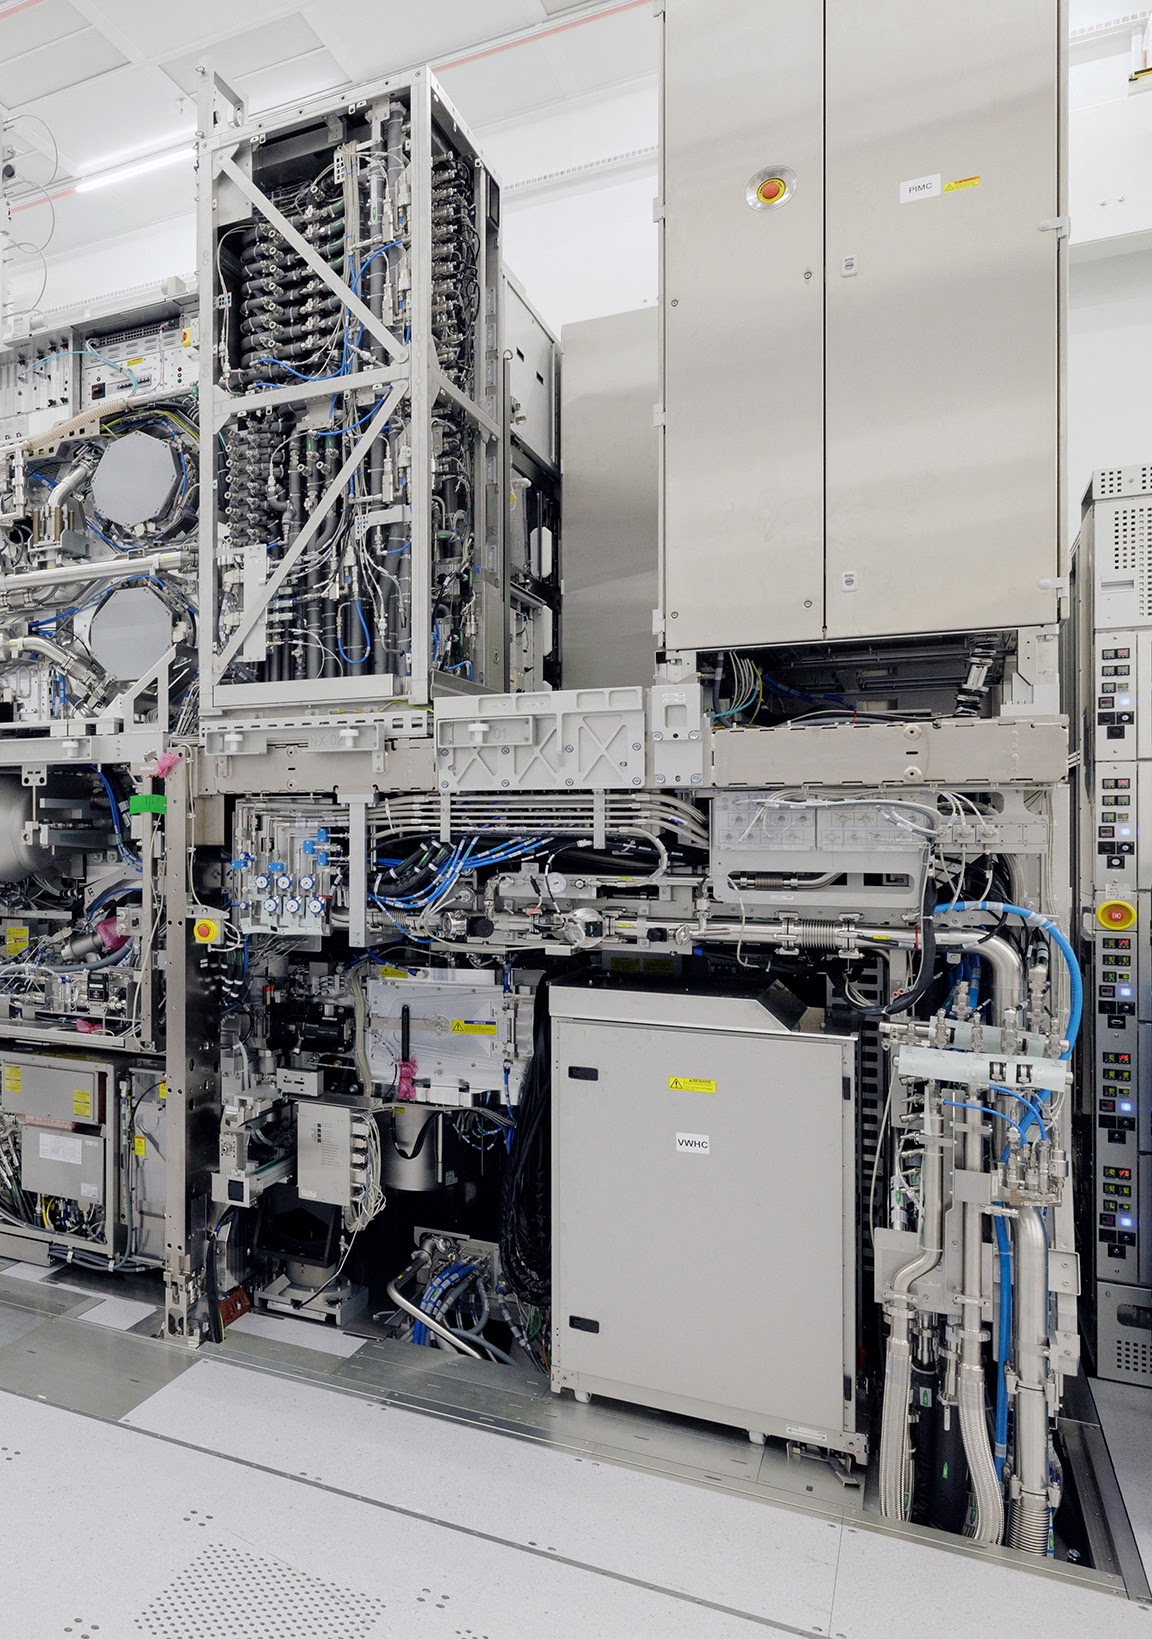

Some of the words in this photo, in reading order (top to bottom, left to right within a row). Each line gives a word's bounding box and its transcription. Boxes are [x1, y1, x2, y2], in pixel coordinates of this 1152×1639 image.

[908, 182, 933, 194] PIMC
[310, 735, 326, 746] NX
[677, 1138, 709, 1149] VWHC
